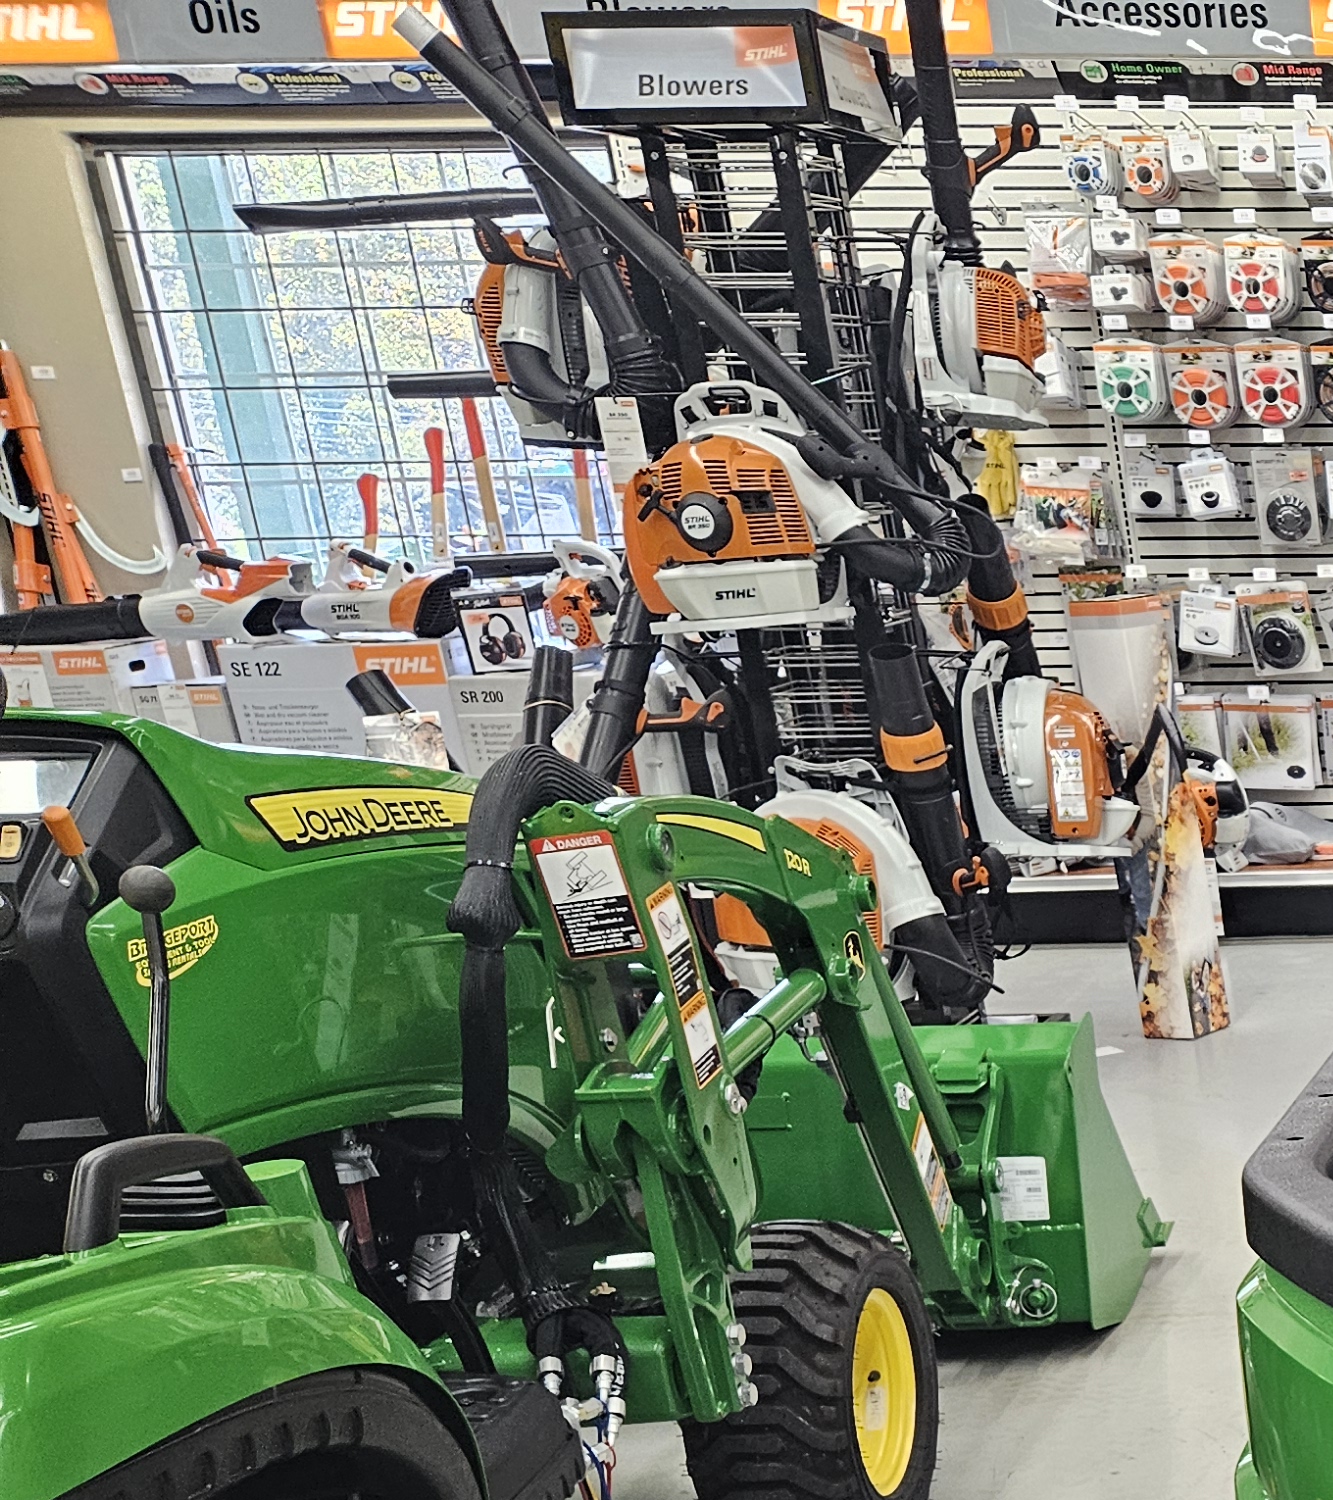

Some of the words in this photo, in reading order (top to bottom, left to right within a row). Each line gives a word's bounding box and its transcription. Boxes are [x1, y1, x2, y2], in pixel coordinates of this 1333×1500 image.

[188, 0, 261, 34] Oils
[1054, 0, 1269, 29] Accessories
[744, 45, 787, 62] STIHL
[953, 68, 1025, 79] Professional
[1112, 63, 1143, 73] Home
[1146, 63, 1183, 75] Owner
[1263, 65, 1285, 75] Mid
[1287, 66, 1323, 77] Range
[267, 73, 342, 84] Professional
[638, 74, 749, 97] Blowers
[685, 515, 711, 524] STIHL
[715, 588, 756, 601] STIHL
[330, 603, 359, 613] STIHL
[58, 656, 102, 669] STIHL
[230, 662, 251, 677] SE
[257, 661, 282, 677] 122
[365, 656, 436, 675] STIHL
[460, 691, 479, 704] SR
[482, 690, 504, 704] 200
[293, 804, 364, 840] JOHN
[362, 798, 453, 833] DEERE
[555, 835, 602, 850] DANGER
